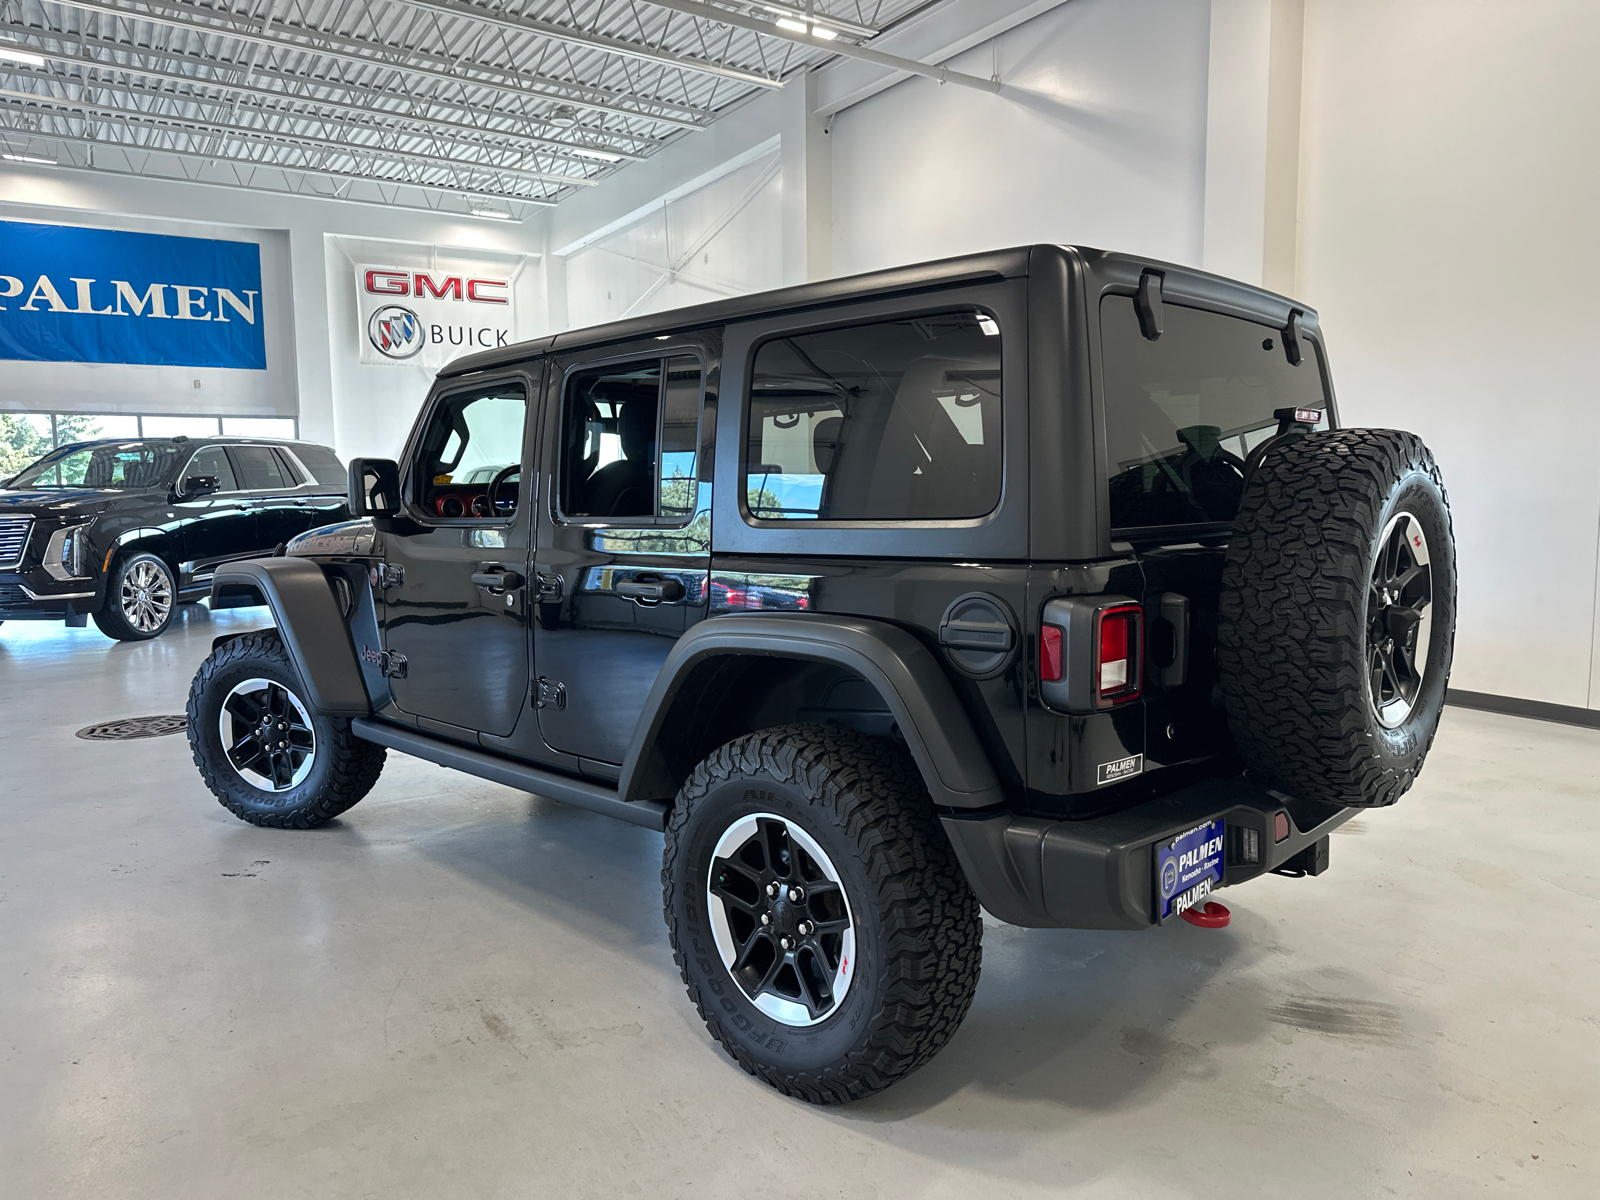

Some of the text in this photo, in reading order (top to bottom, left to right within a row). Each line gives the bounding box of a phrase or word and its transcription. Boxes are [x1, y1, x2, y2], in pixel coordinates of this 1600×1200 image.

[0, 274, 259, 325] PALMEN
[364, 268, 509, 306] GMC
[431, 324, 509, 348] BUICK
[288, 535, 349, 553] RUBICON
[1105, 757, 1136, 775] PALMEN
[1174, 820, 1212, 844] palmen.com
[1179, 834, 1224, 873] PALMEN
[1181, 867, 1201, 883] Kenosha
[1204, 857, 1219, 871] Racine
[1176, 877, 1211, 916] PALMEN
